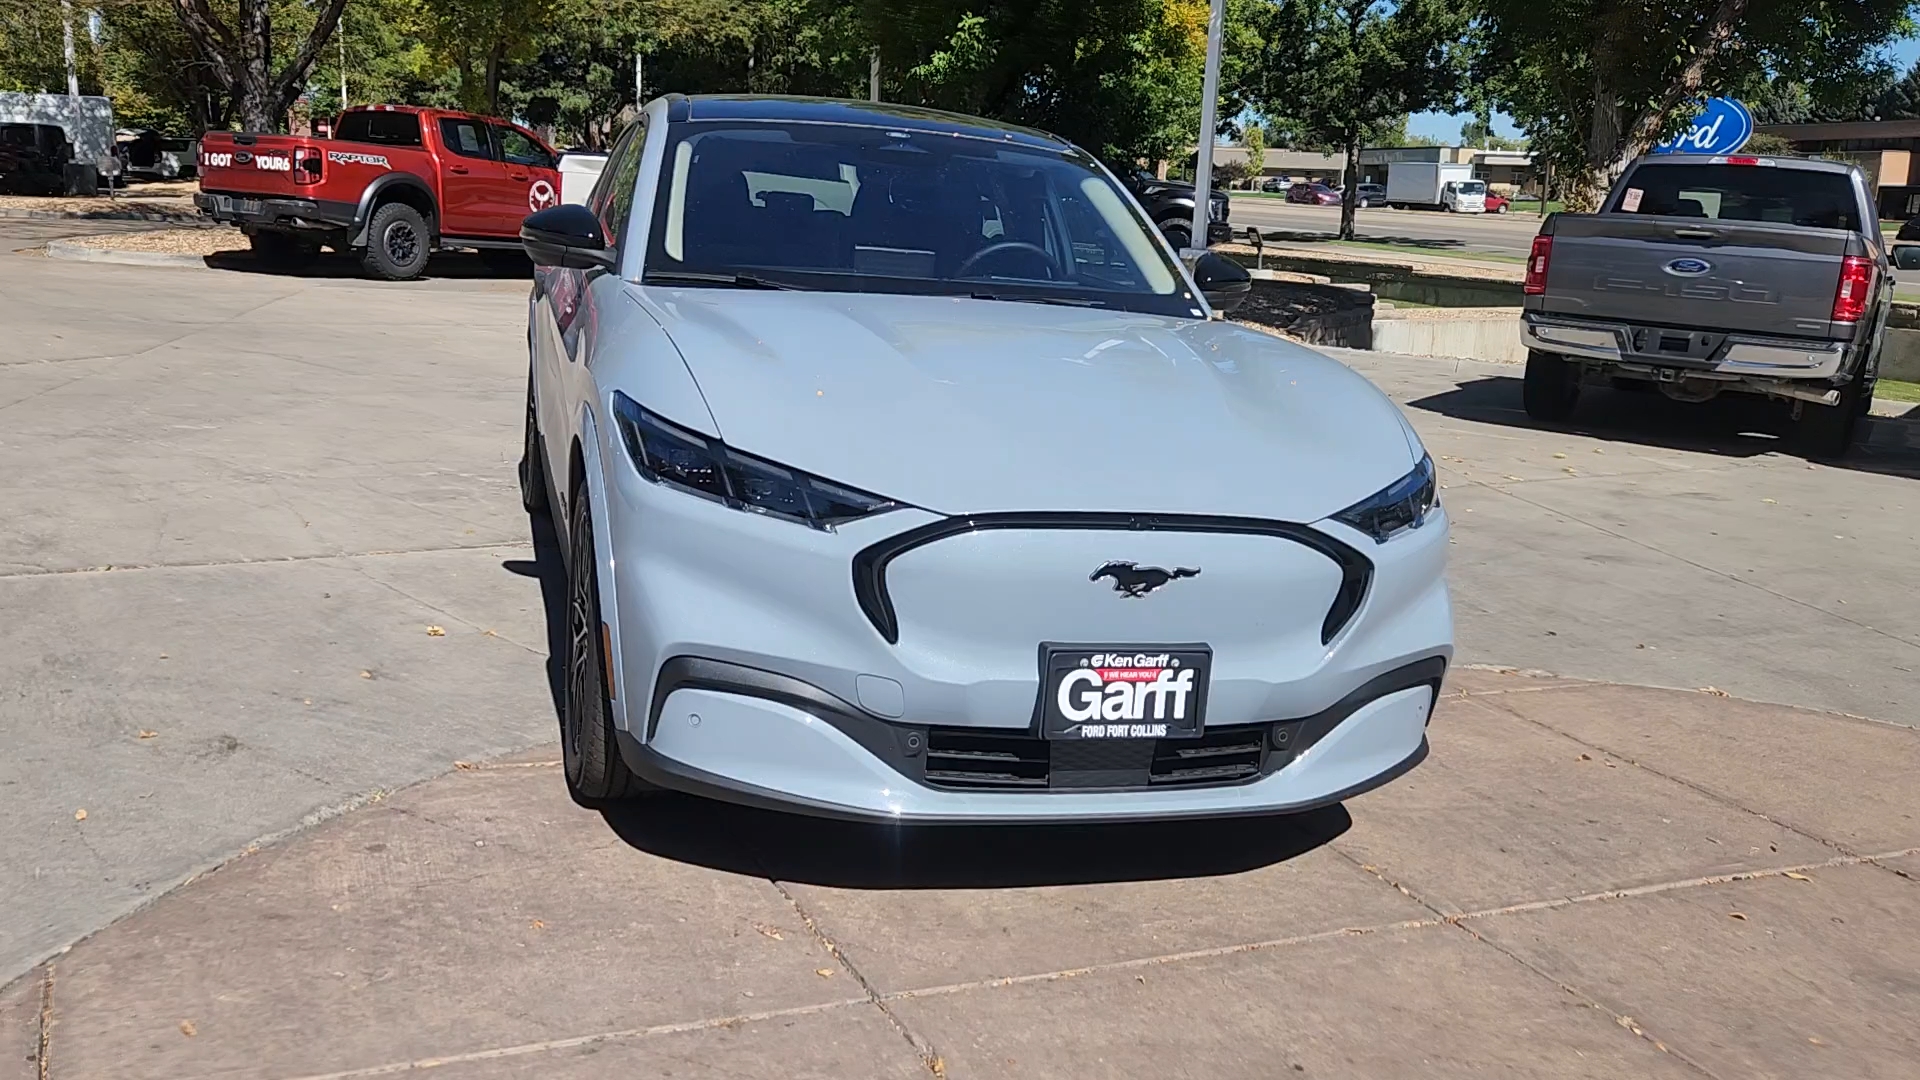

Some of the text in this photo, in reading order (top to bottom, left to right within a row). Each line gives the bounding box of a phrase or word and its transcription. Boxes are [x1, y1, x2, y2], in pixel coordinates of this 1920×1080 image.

[204, 152, 210, 165] I
[210, 153, 233, 167] GOT
[255, 155, 291, 171] YOUR6
[328, 151, 392, 170] RAPTOR
[1104, 653, 1133, 667] Ken
[1133, 653, 1170, 667] Garff
[1120, 671, 1138, 679] HEAR
[1057, 668, 1194, 722] Garff
[1081, 723, 1167, 738] FORD FORT COLLINS
